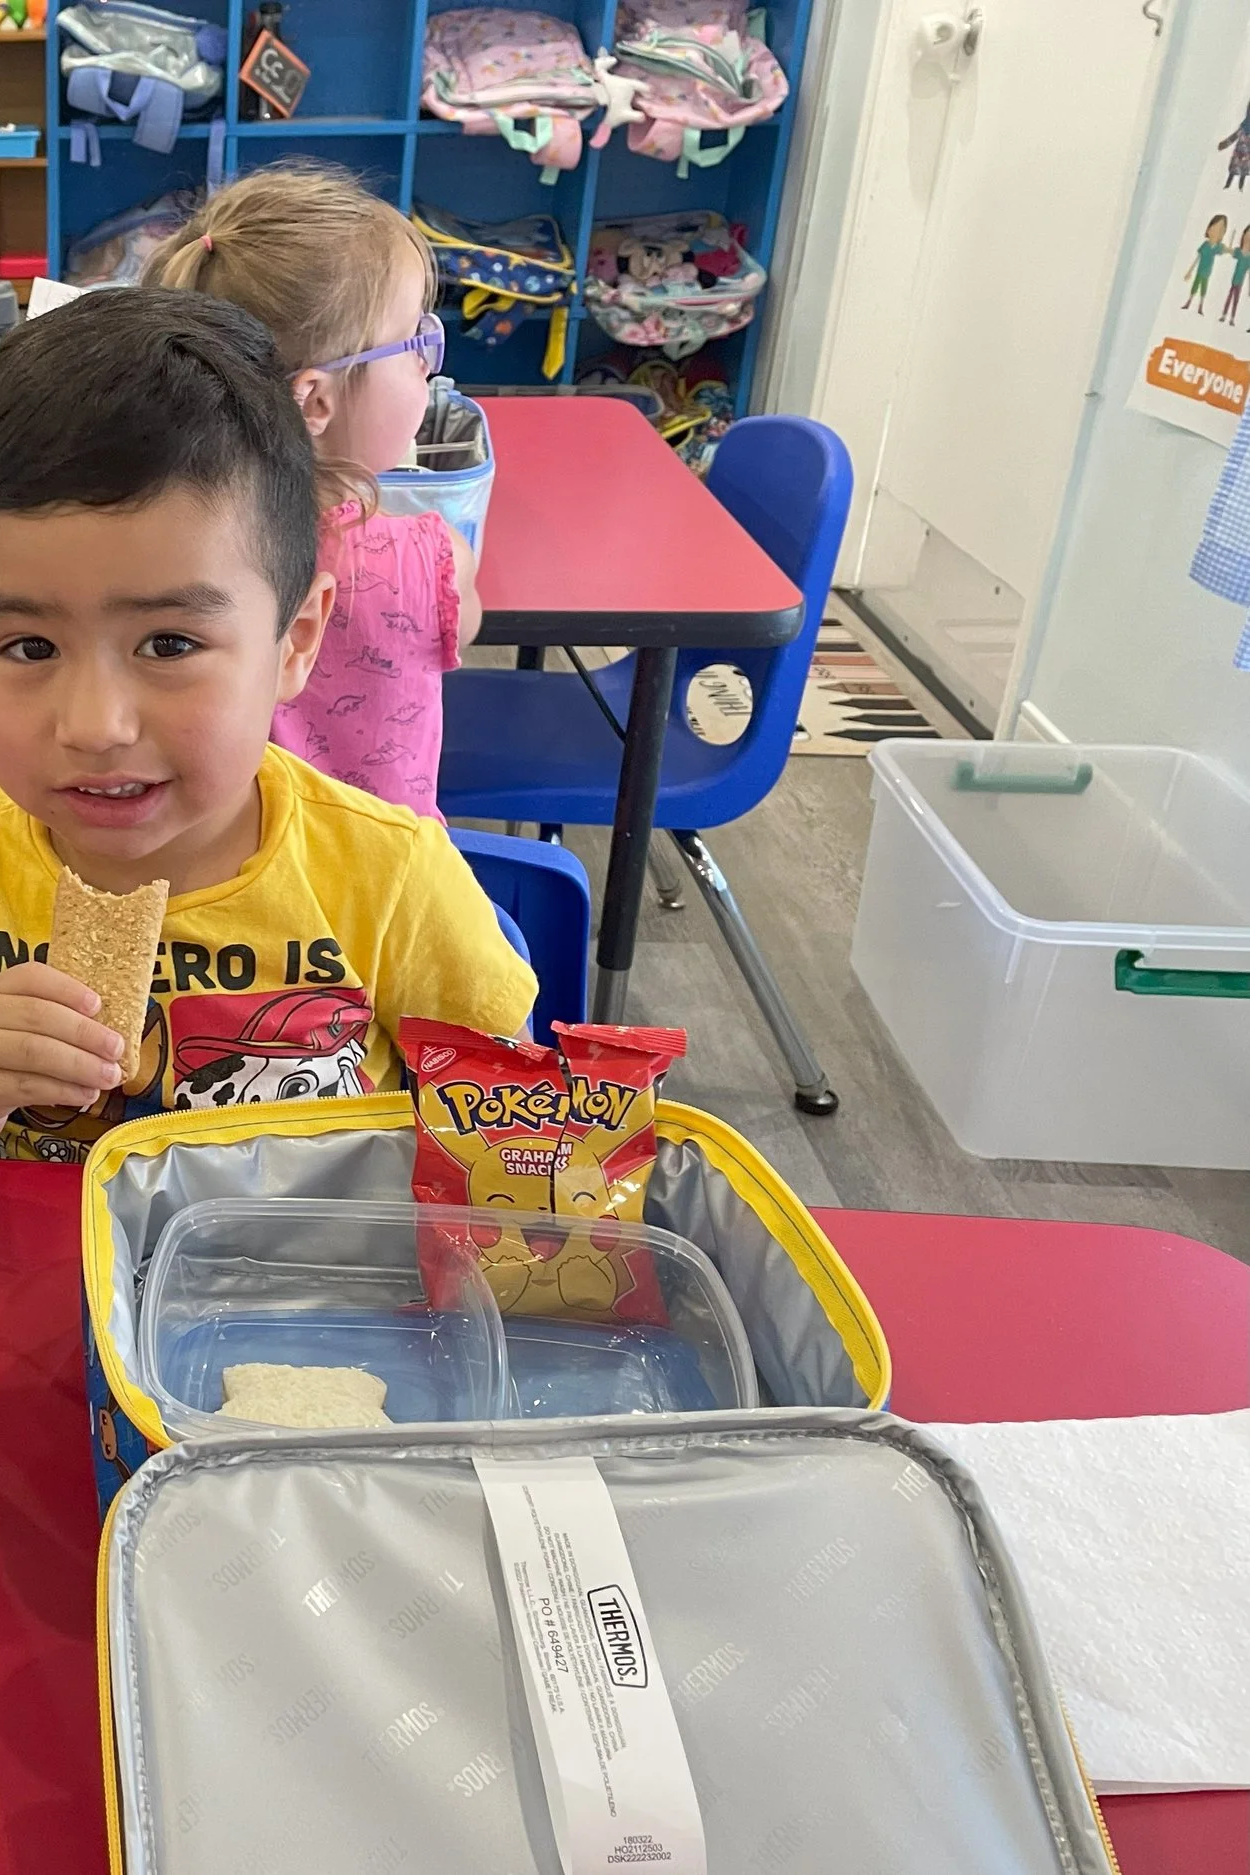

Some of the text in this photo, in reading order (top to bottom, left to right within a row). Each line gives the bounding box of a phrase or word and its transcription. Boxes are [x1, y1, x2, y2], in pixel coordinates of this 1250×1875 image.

[1158, 348, 1243, 404] Everyone
[285, 937, 346, 985] IS
[423, 1049, 453, 1070] NABISCO
[538, 1596, 568, 1675] PO # 649427
[623, 1835, 653, 1845] 180322
